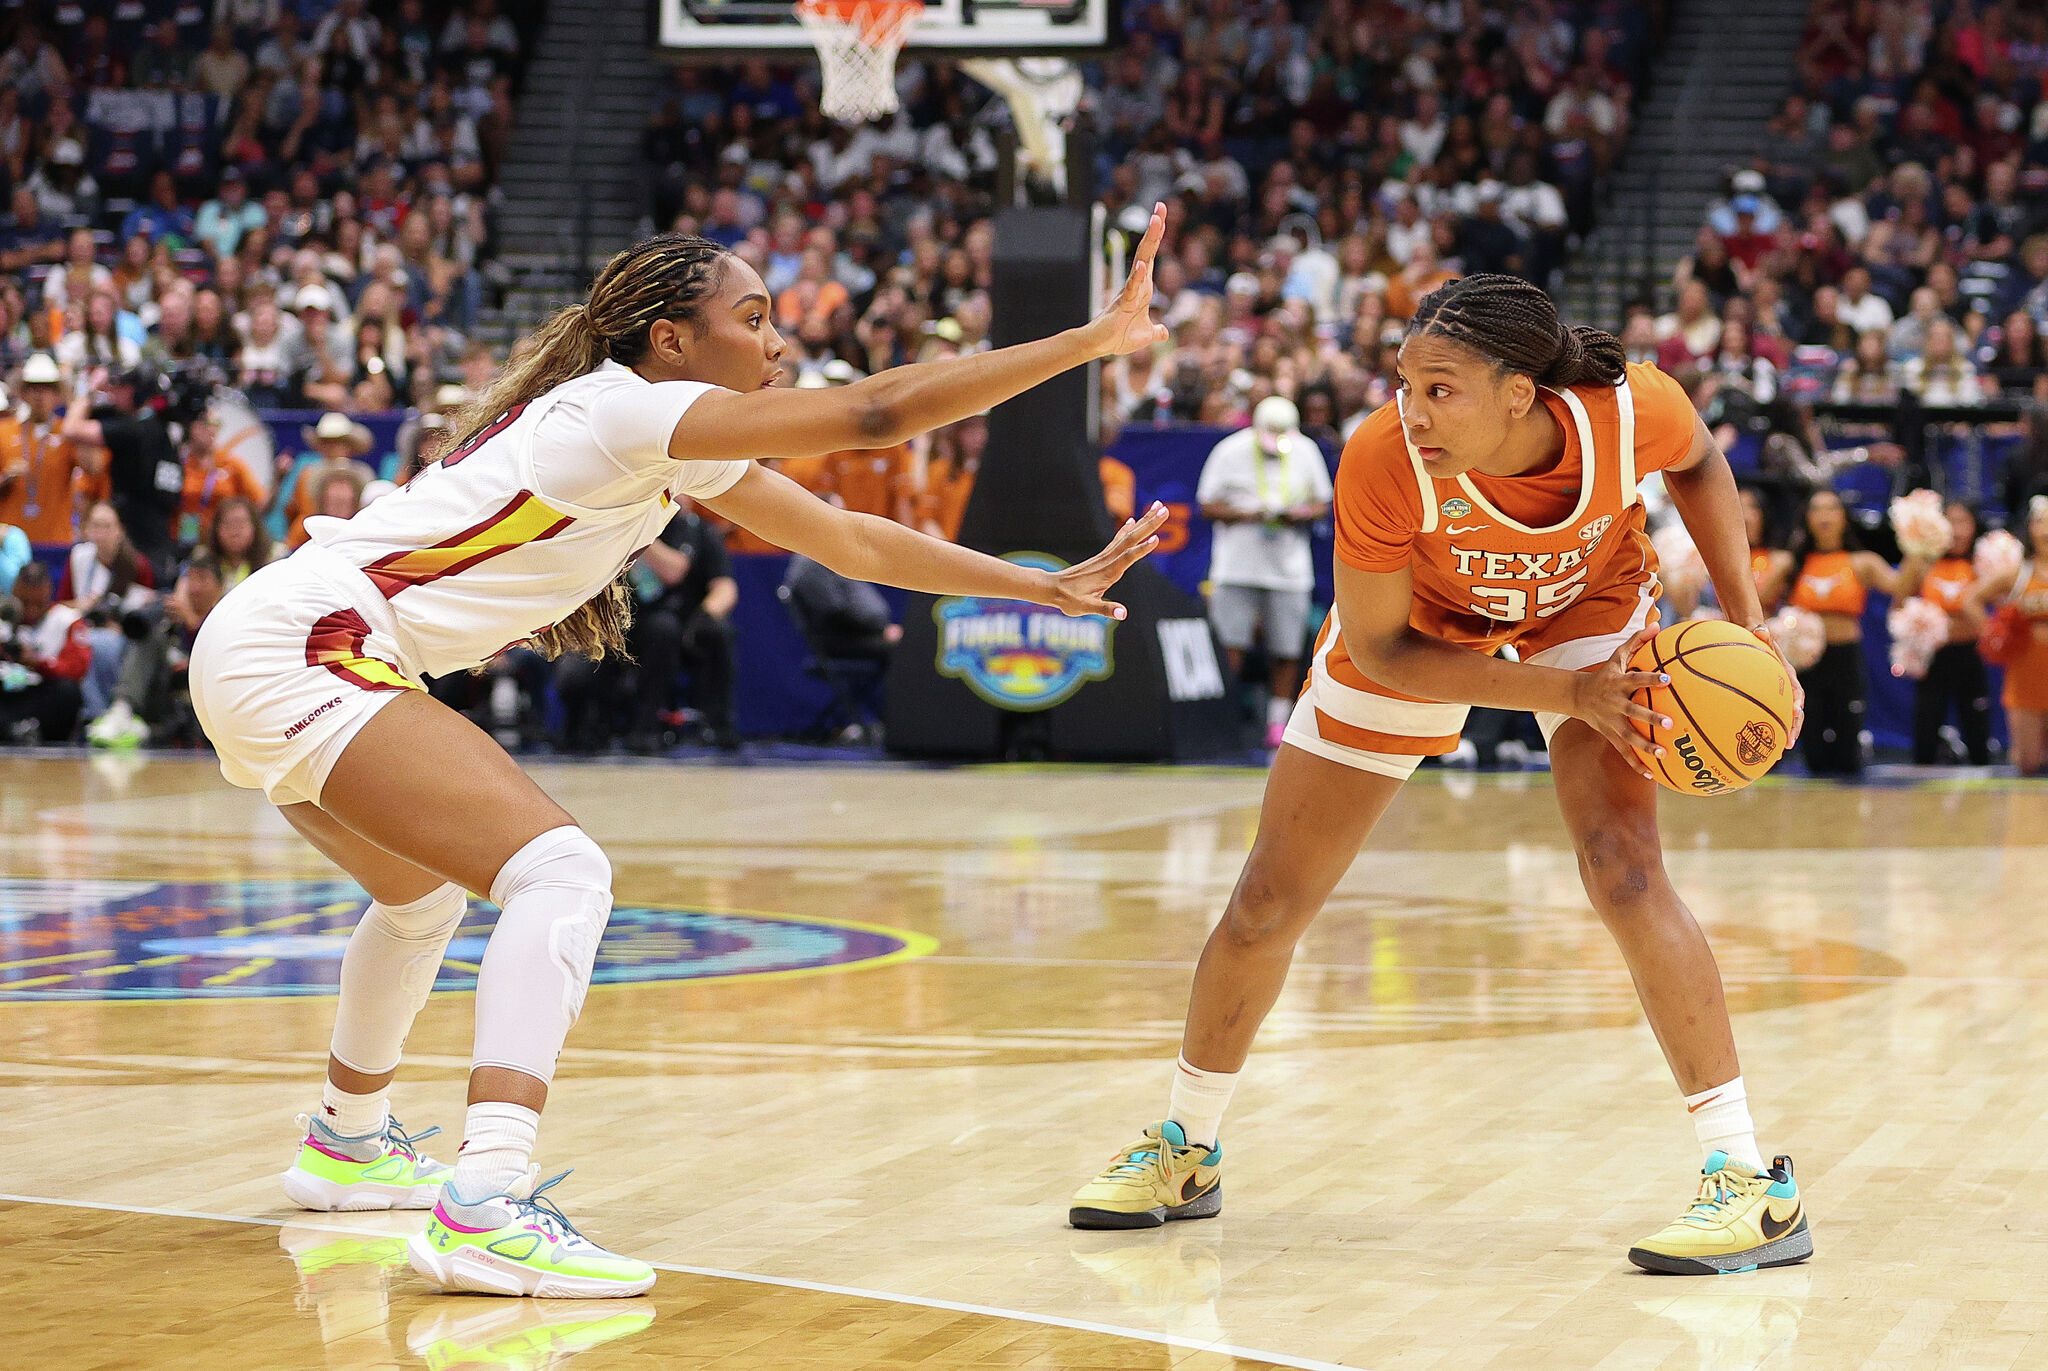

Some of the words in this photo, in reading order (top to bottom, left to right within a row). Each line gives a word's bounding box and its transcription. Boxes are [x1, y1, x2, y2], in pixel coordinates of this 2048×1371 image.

[1580, 515, 1611, 538] SEC
[1450, 534, 1603, 581] TEXAS
[1470, 565, 1589, 622] 35
[944, 612, 1024, 650] FINAL
[1028, 613, 1105, 653] FOUR
[284, 696, 343, 740] GAMECOCKS
[1741, 726, 1760, 748] FOUR
[1674, 733, 1737, 794] ilson
[466, 1249, 496, 1265] FLOW
